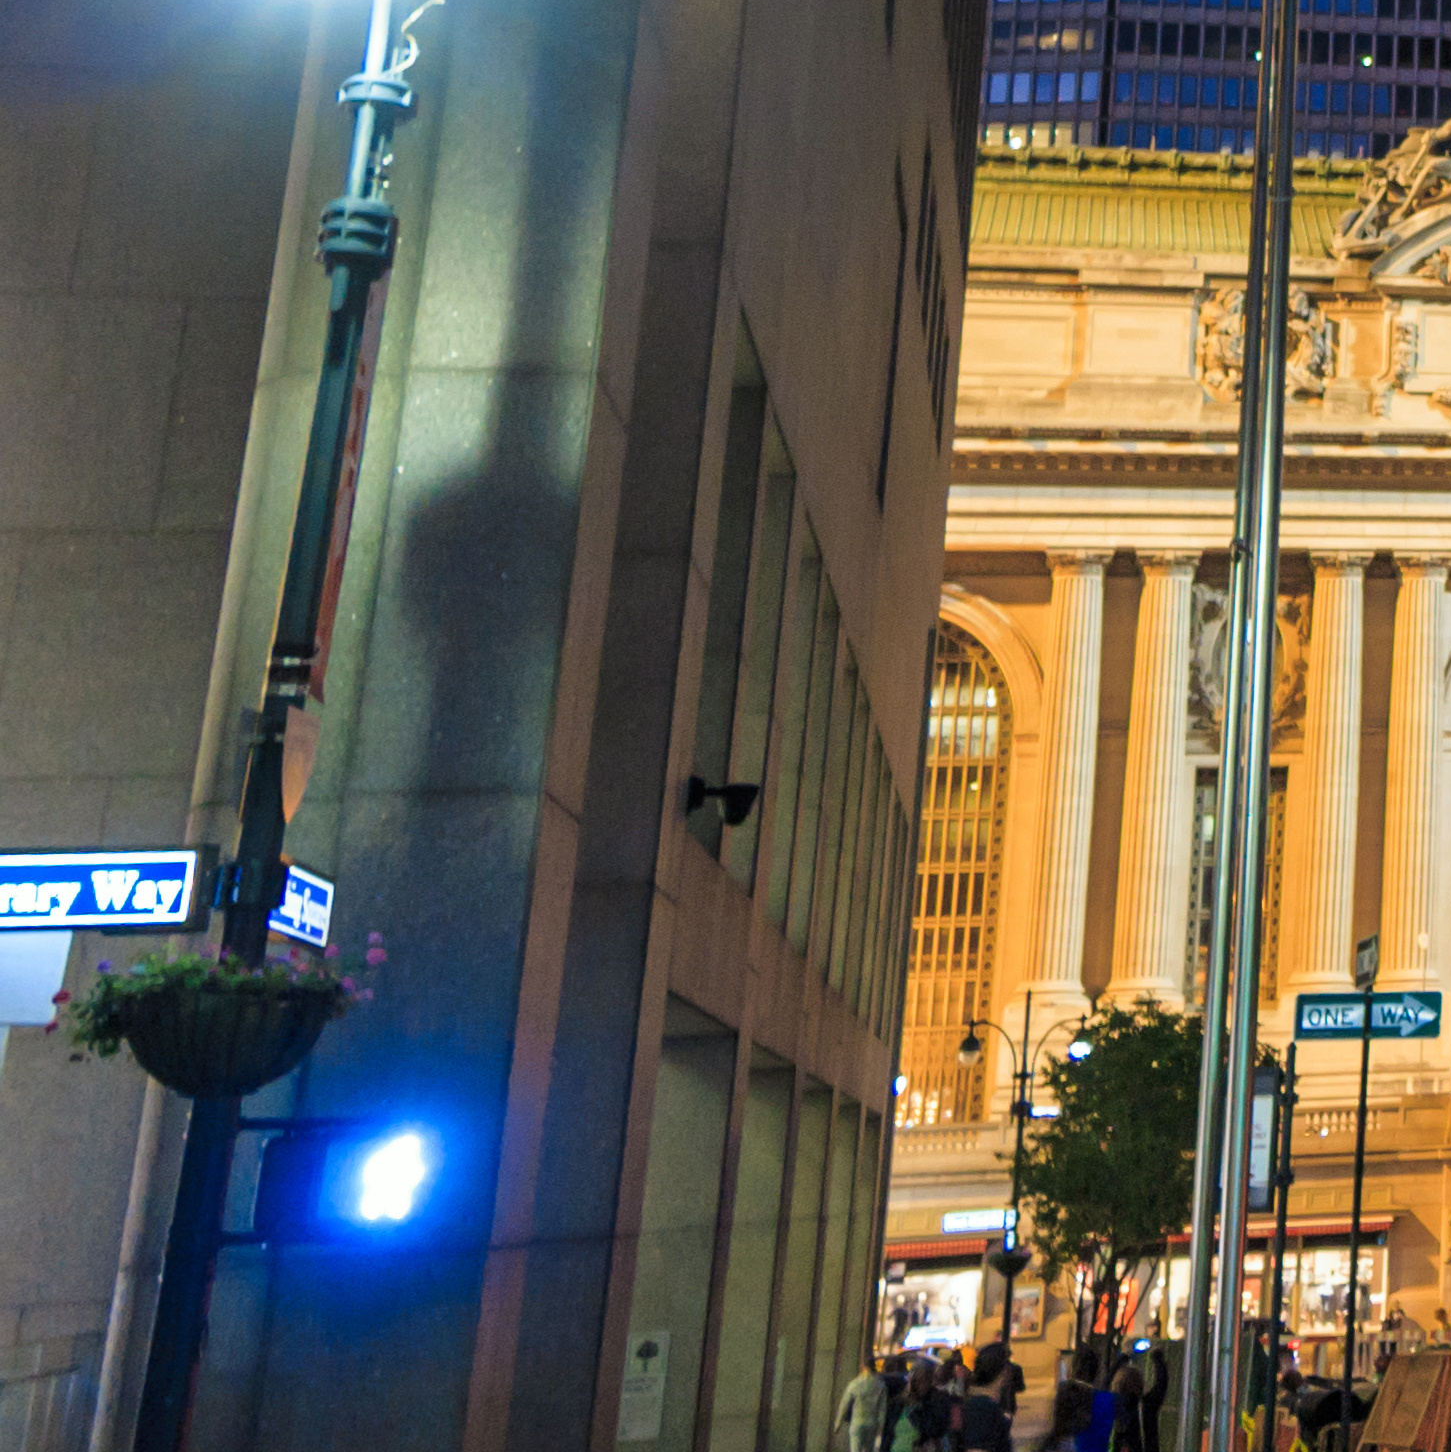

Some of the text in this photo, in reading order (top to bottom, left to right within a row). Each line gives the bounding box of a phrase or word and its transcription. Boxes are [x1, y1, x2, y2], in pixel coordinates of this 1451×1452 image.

[91, 869, 183, 917] Way
[1307, 1006, 1425, 1027] ONE WAY
